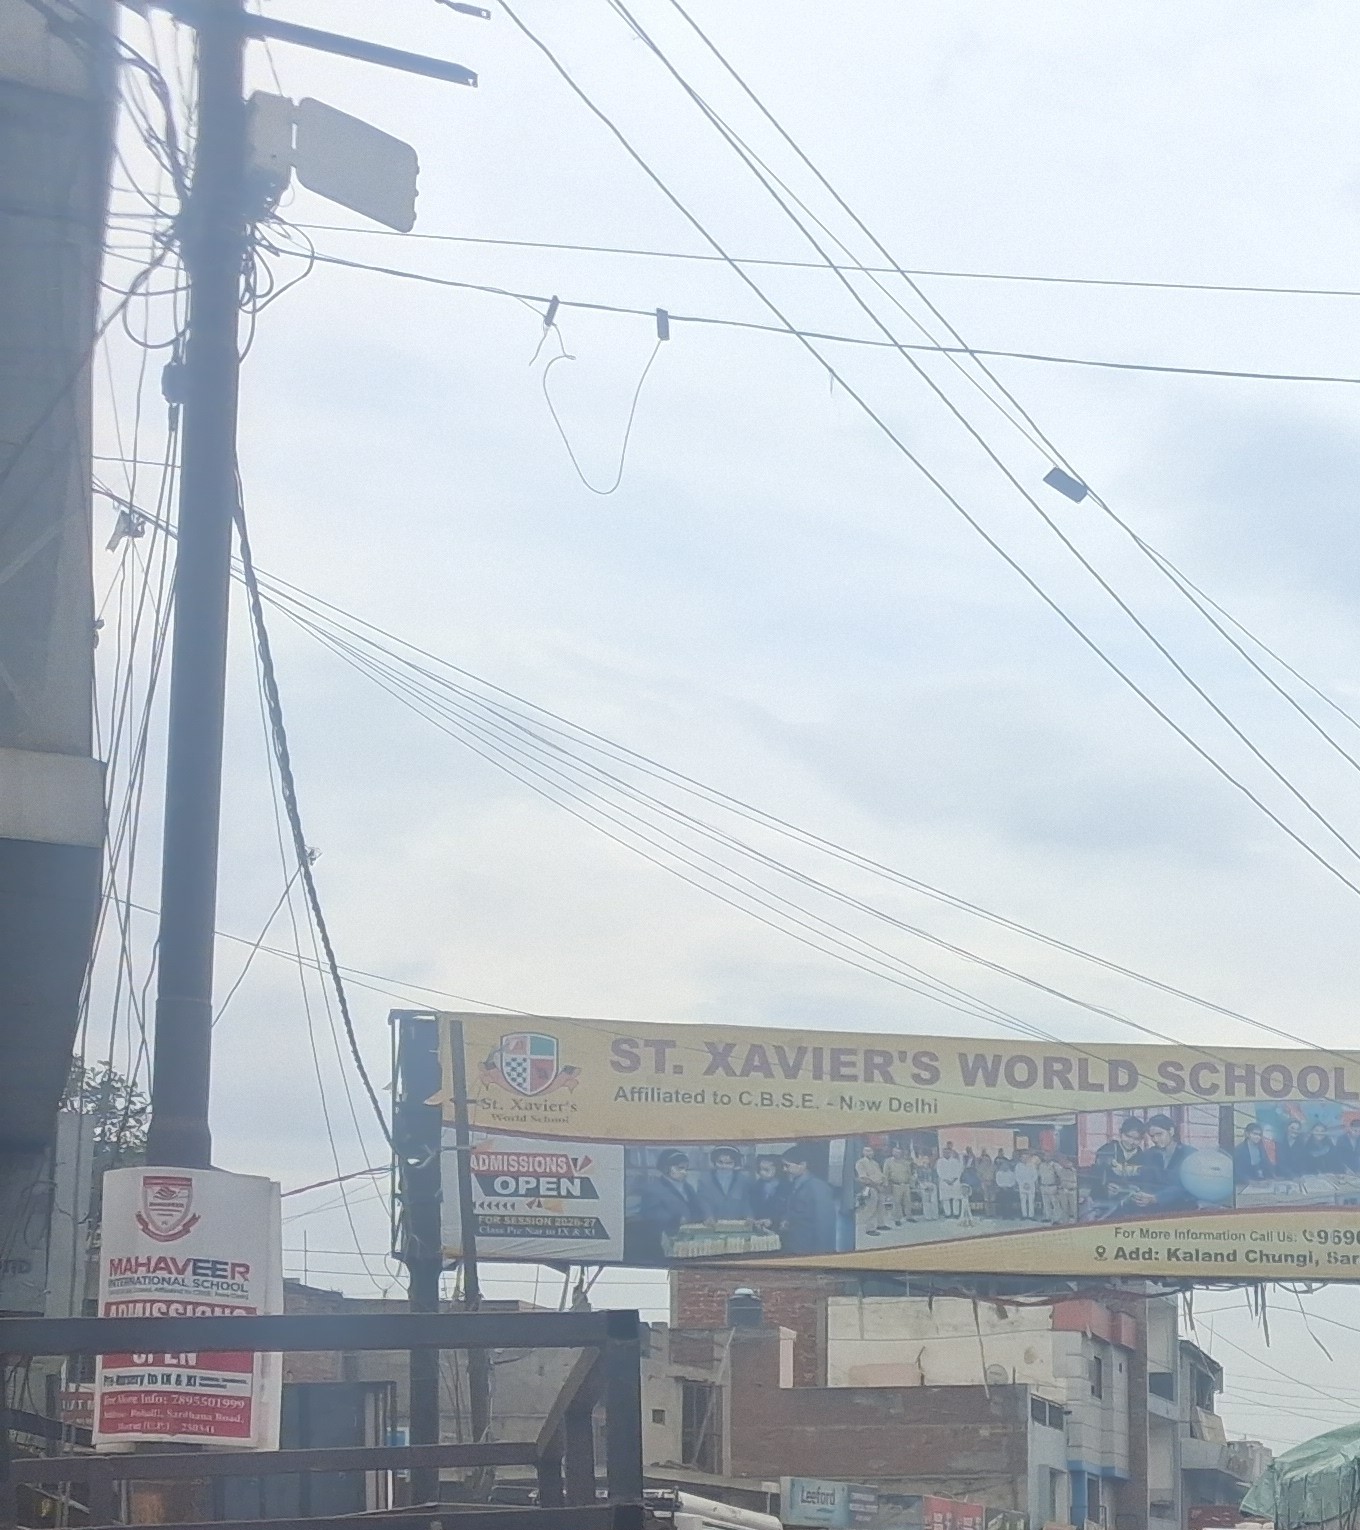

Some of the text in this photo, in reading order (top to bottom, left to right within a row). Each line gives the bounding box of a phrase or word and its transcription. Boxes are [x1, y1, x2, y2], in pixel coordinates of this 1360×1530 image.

[610, 1037, 1360, 1101] ST. XAVIER'S WORLD SCHOOL
[510, 1098, 577, 1113] Xavier's
[614, 1086, 705, 1105] Affiliated
[713, 1089, 731, 1106] to
[738, 1091, 820, 1110] C.B.S.E.
[840, 1095, 881, 1113] New
[889, 1097, 938, 1115] Delhi
[470, 1153, 568, 1174] ADMISSIONS
[493, 1175, 581, 1197] OPEN
[479, 1215, 501, 1226] FOR
[504, 1216, 551, 1227] SESSION
[1114, 1227, 1135, 1241] For
[1140, 1227, 1170, 1242] More
[1174, 1228, 1246, 1244] Information
[1250, 1228, 1274, 1243] Call
[1277, 1230, 1298, 1244] Us:
[1113, 1246, 1160, 1262] Add:
[1166, 1248, 1237, 1264] Kaland
[109, 1256, 250, 1281] MAHAVEER
[192, 1279, 249, 1294] SCHOOL
[141, 1393, 168, 1406] Info:
[801, 1487, 836, 1506] Leeford
